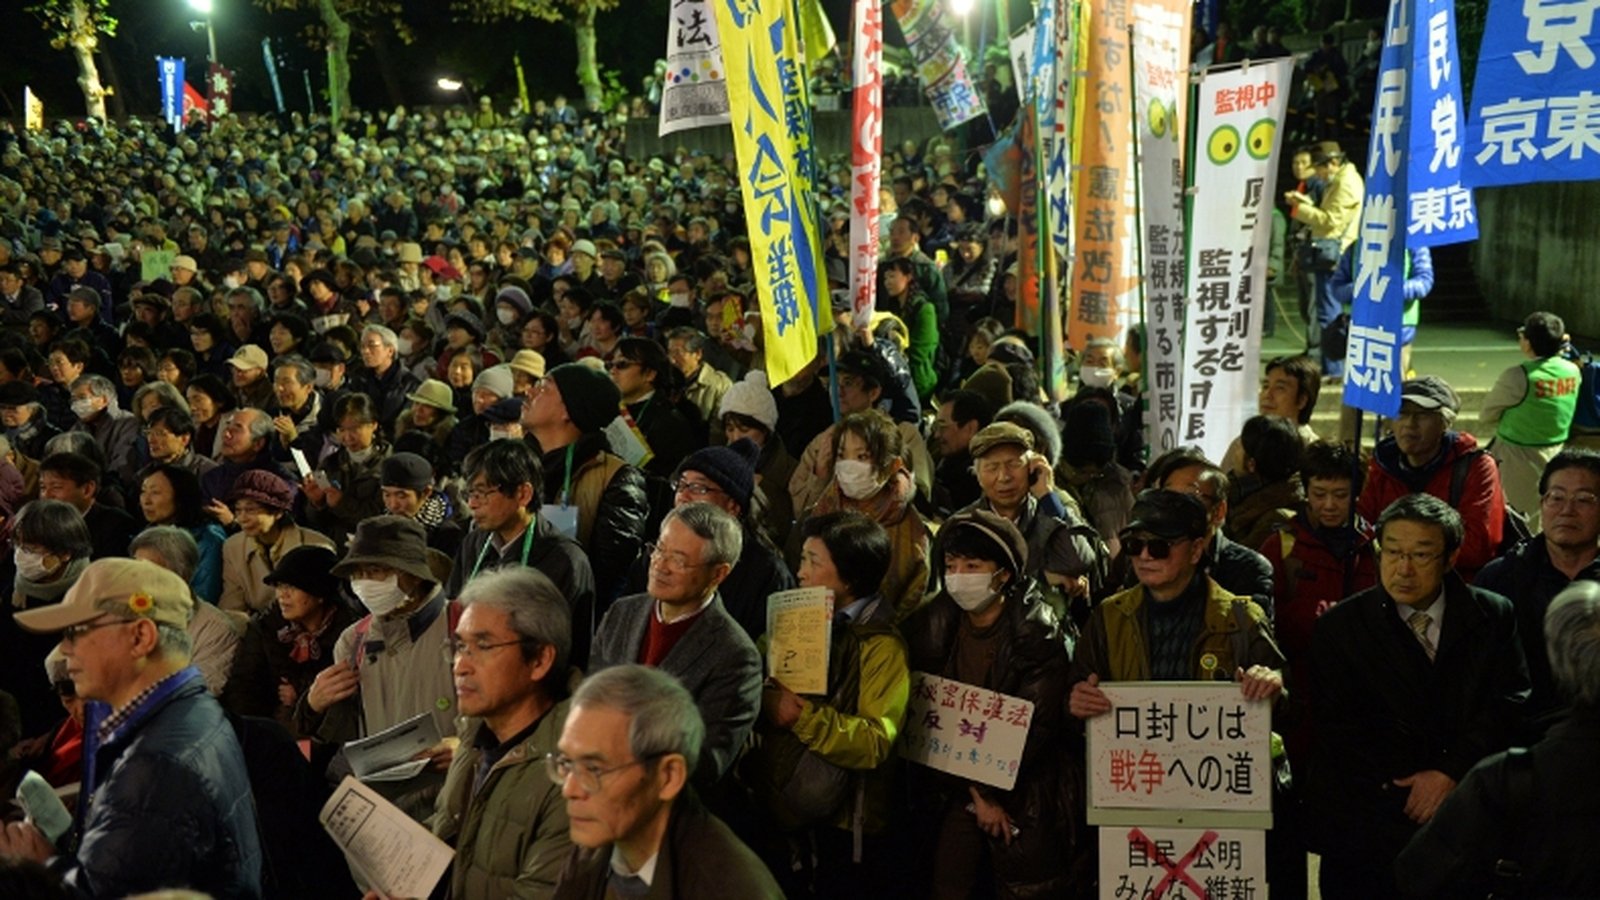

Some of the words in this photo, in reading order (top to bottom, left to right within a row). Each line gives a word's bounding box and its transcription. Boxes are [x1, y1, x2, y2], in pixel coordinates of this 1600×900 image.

[1214, 81, 1275, 115] 監視中
[1408, 181, 1474, 235] 東京
[1185, 248, 1233, 454] 監視する市民
[914, 676, 1029, 728] 秘密保護法
[1115, 702, 1246, 742] 口封じは
[922, 710, 988, 744] 反対
[1109, 750, 1254, 795] 戦争への道
